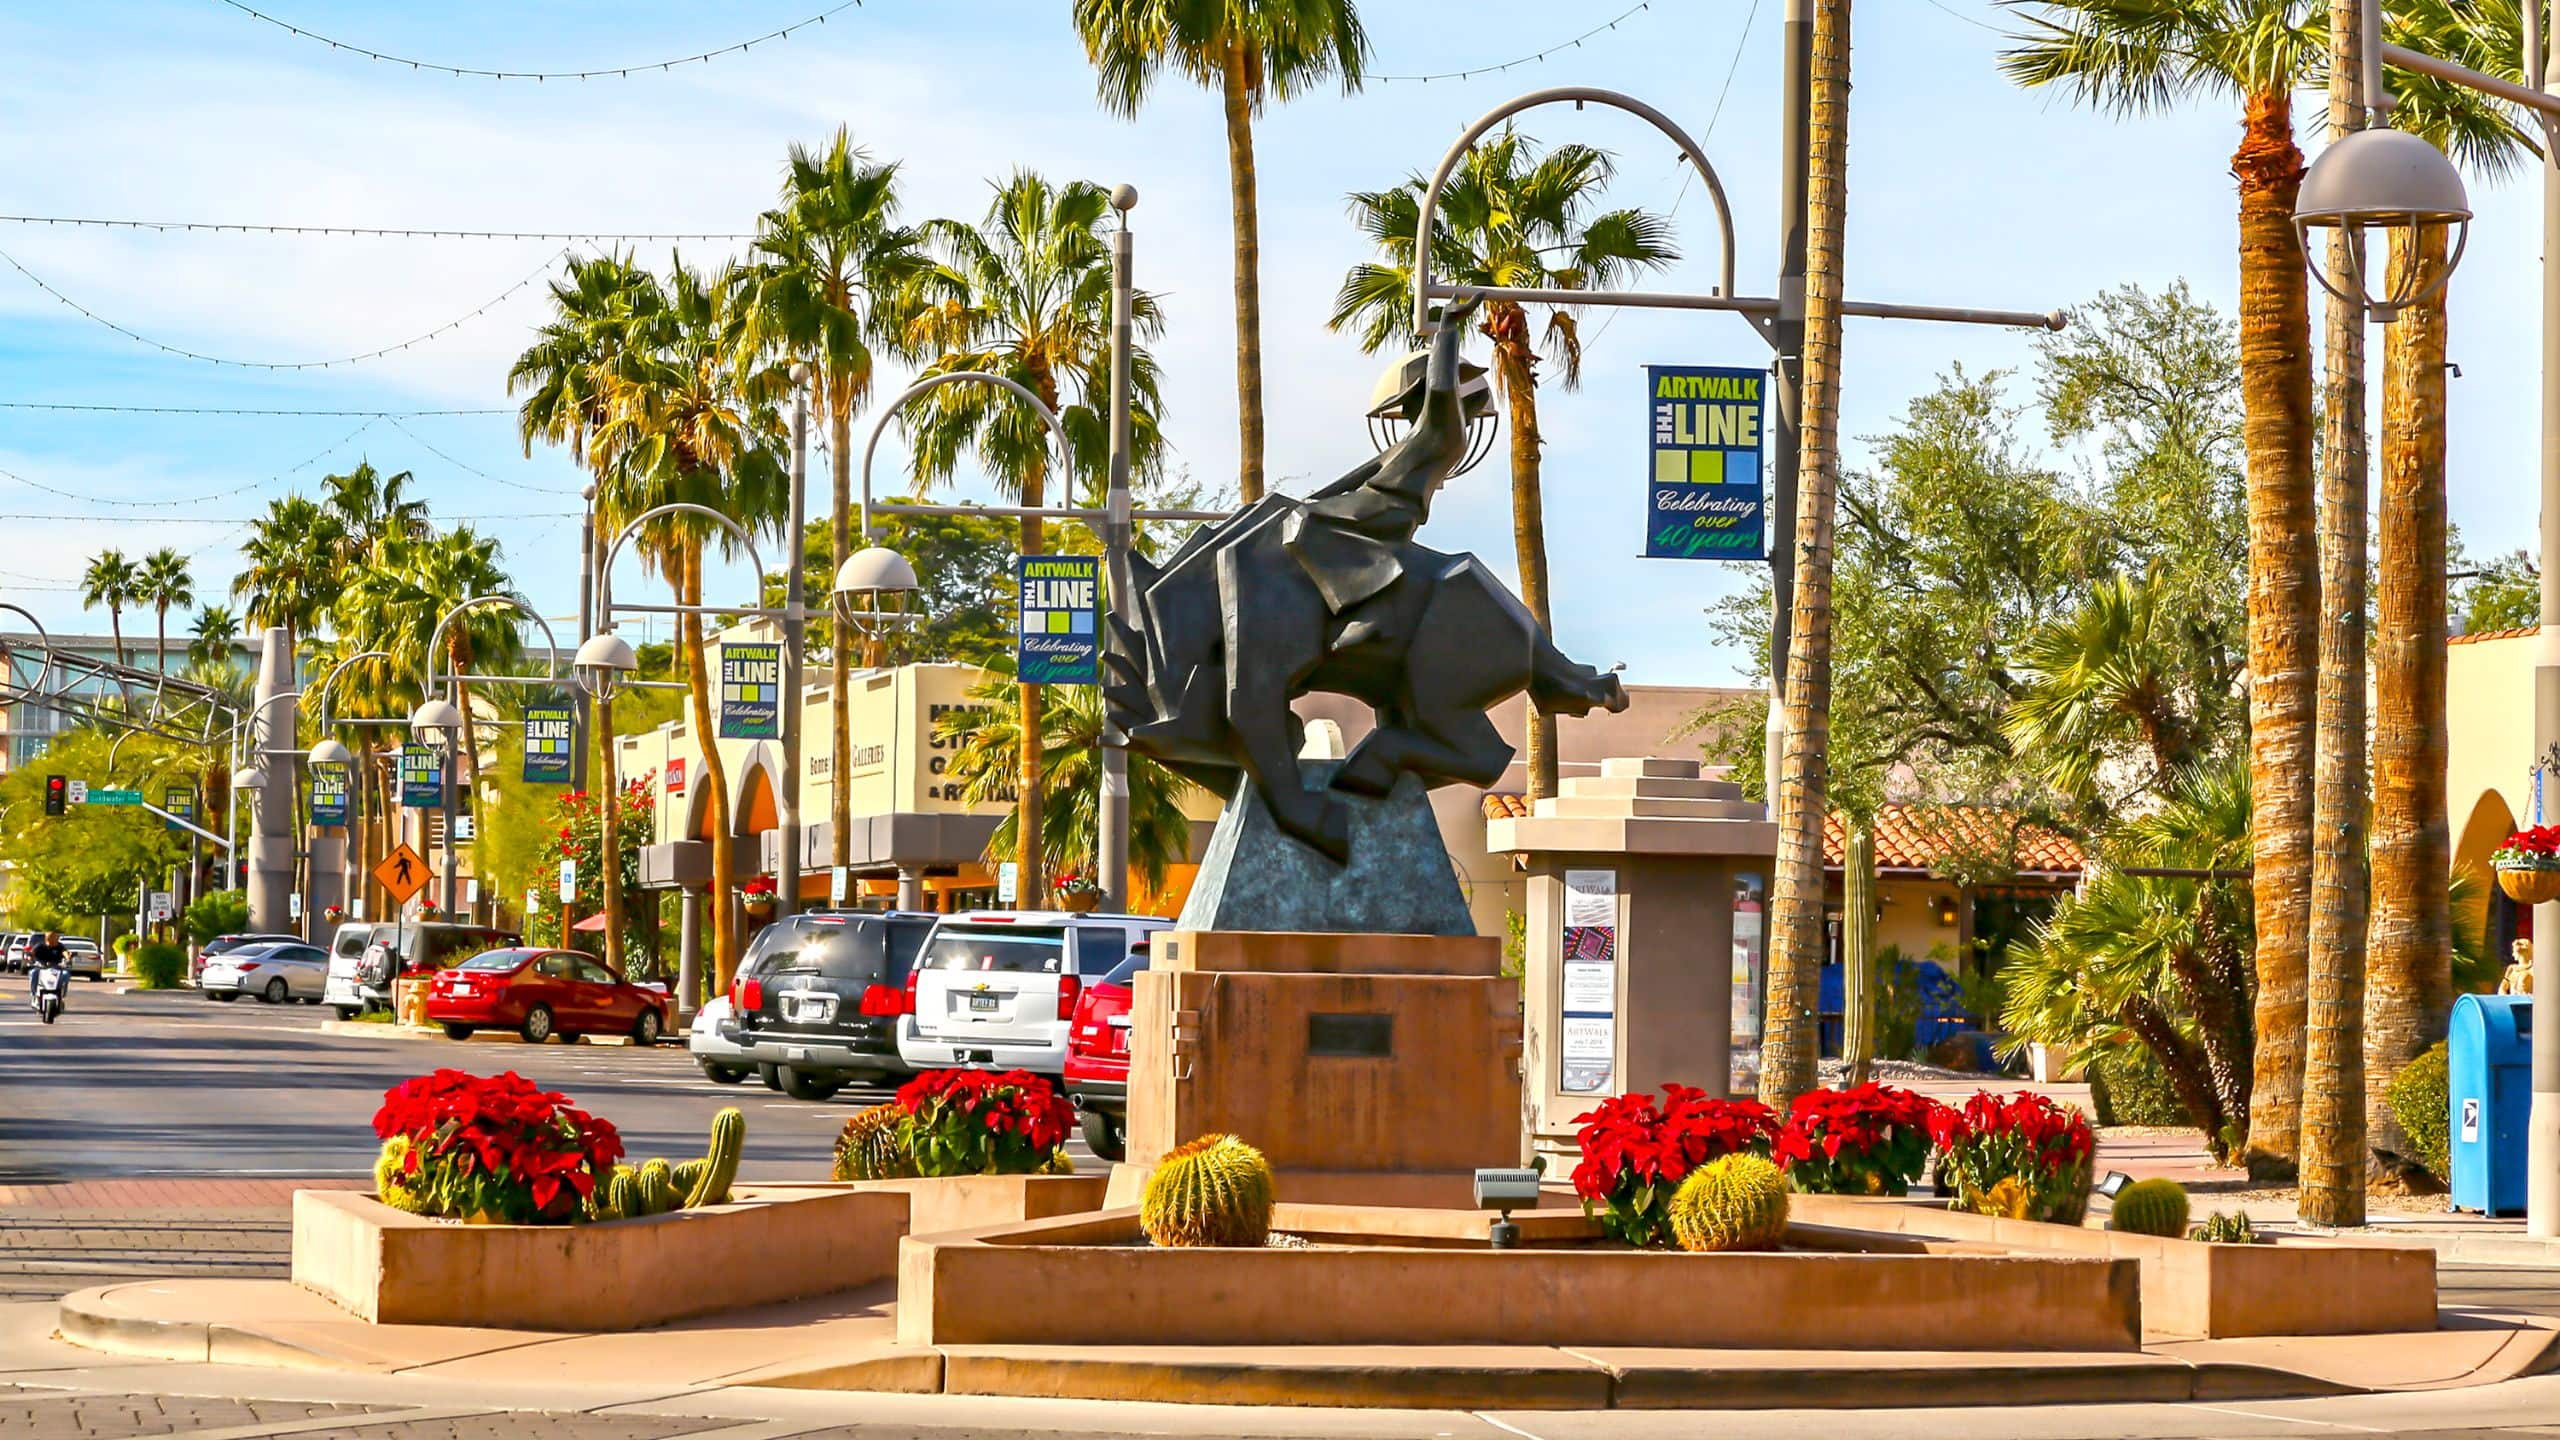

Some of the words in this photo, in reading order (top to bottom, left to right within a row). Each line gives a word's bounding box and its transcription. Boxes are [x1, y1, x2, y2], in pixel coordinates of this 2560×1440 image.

[1656, 376, 1759, 401] ARTWALK
[1656, 403, 1673, 444] THE
[1674, 403, 1759, 447] LINE
[1656, 490, 1757, 519] Celebrating
[1694, 515, 1739, 529] over
[1654, 524, 1688, 547] 40
[1683, 528, 1759, 557] years
[1024, 562, 1094, 578] ARTWALK
[1024, 580, 1035, 608] THE
[1037, 580, 1094, 609] LINE
[725, 648, 777, 659] ARTWALK
[1024, 638, 1093, 656] Celebrating
[1049, 654, 1080, 663] over
[724, 661, 733, 682] THE
[734, 661, 777, 683] LINE
[1023, 661, 1047, 676] 40
[1043, 663, 1094, 682] years
[528, 710, 569, 720] ARTWALK
[724, 704, 775, 720] Celebrating
[535, 721, 569, 738] LINE
[411, 755, 440, 769] LINE
